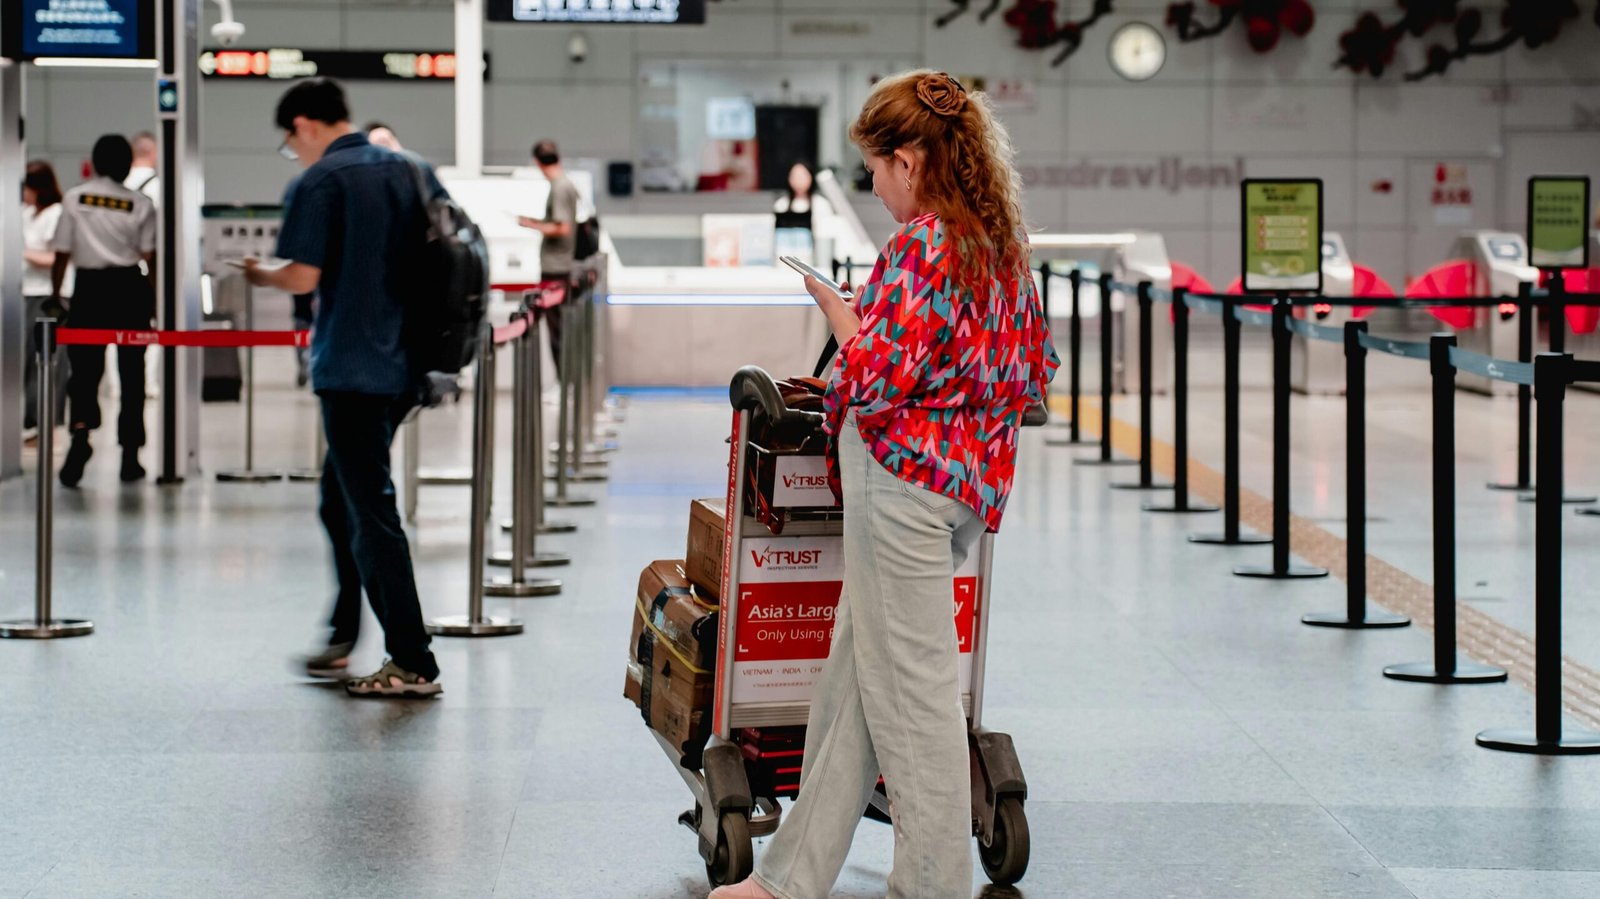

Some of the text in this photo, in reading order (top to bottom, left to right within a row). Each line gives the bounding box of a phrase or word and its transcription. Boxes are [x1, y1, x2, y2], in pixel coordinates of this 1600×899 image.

[1021, 157, 1244, 194] ozdravljeni
[727, 486, 735, 532] Helping
[748, 604, 794, 619] Asia's
[757, 629, 787, 643] Only
[790, 628, 825, 642] Using
[742, 668, 773, 676] VIETNAM
[782, 667, 801, 675] INDIA
